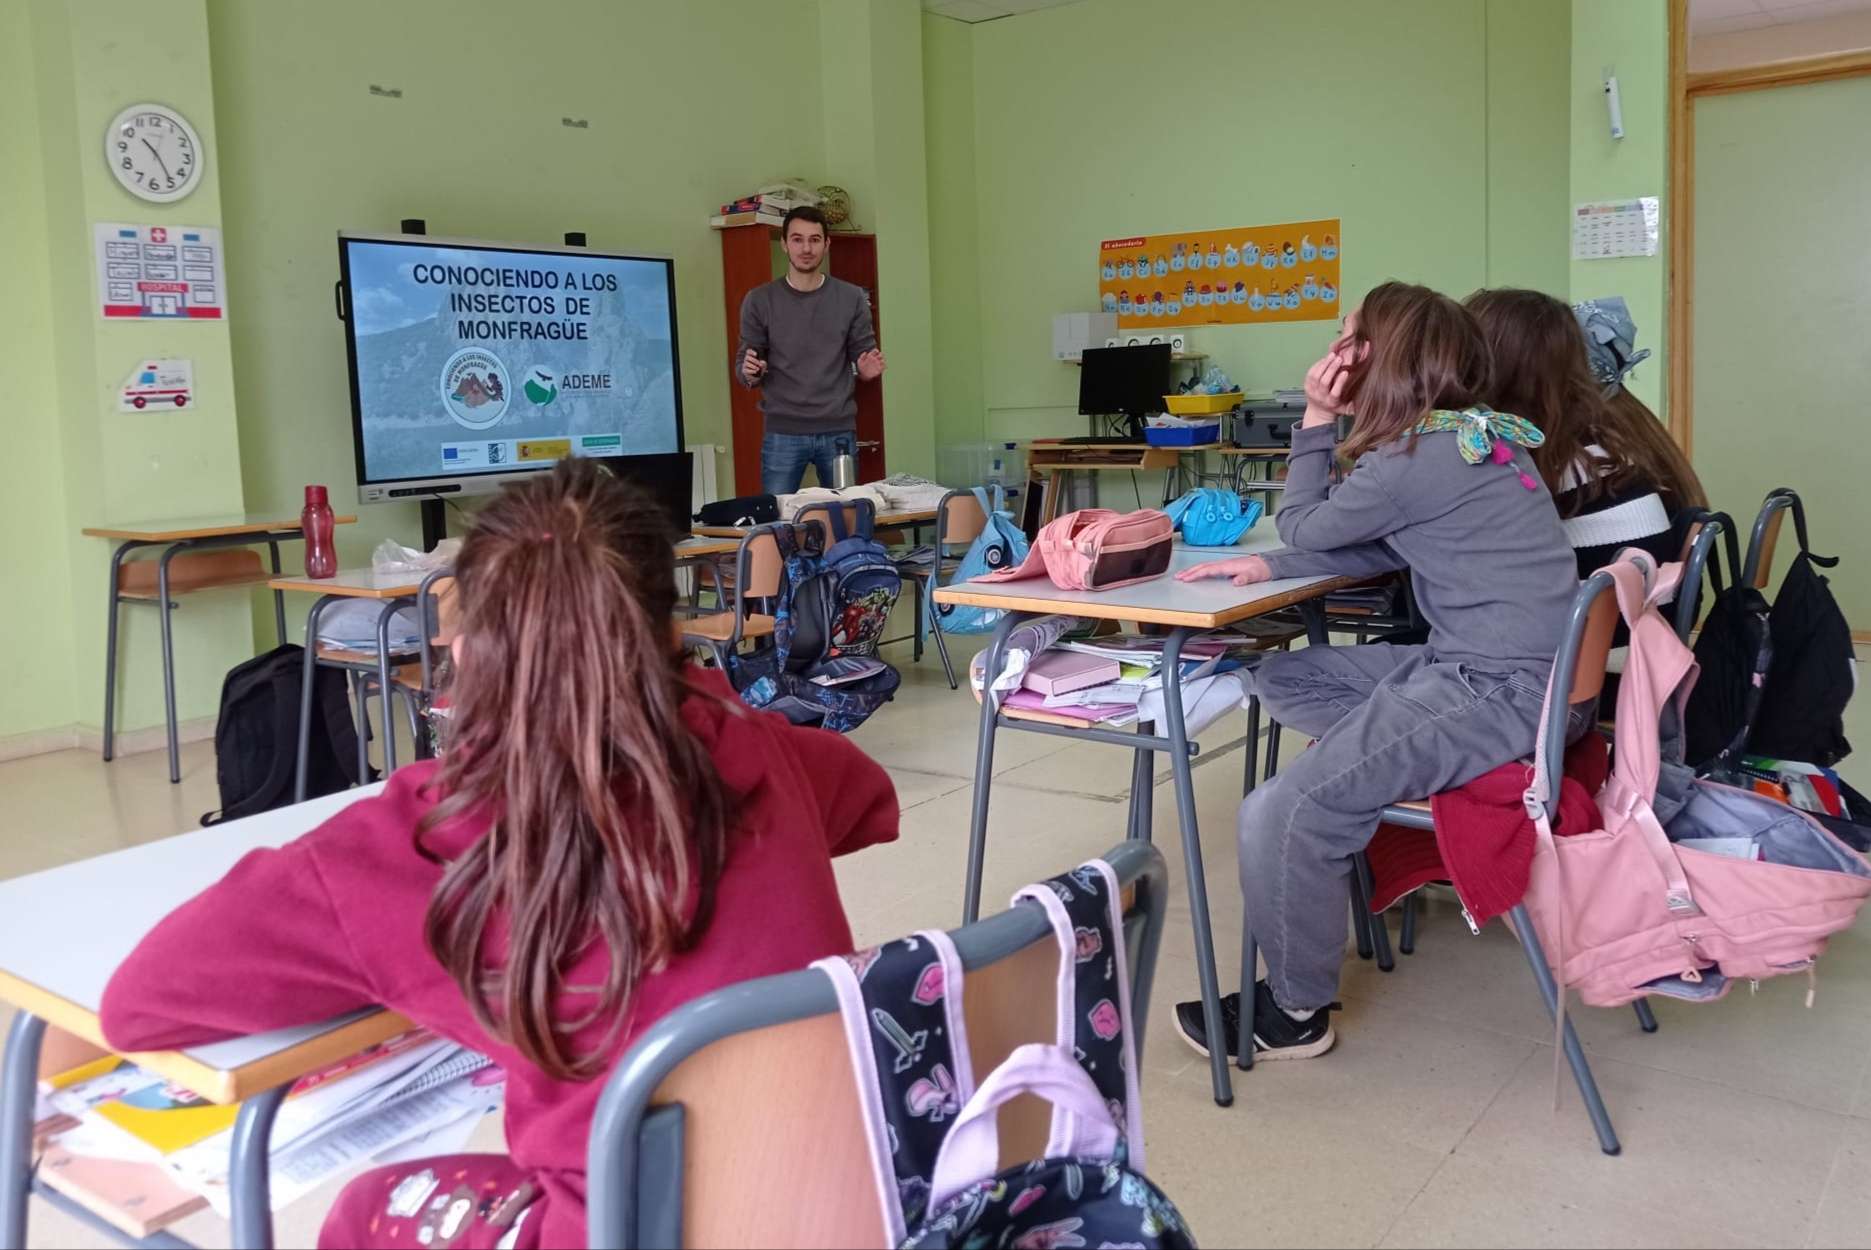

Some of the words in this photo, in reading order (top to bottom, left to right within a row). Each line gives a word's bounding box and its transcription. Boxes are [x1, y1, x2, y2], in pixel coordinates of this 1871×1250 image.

[149, 116, 161, 128] 12
[122, 127, 135, 138] 10
[118, 141, 128, 153] 9
[177, 137, 187, 148] 2
[122, 157, 133, 170] 8
[182, 153, 191, 165] 3
[135, 171, 144, 183] 7
[176, 168, 186, 179] 4
[148, 178, 159, 191] 6
[166, 176, 175, 189] 5
[413, 263, 559, 290] CONOCIENDO
[564, 272, 577, 290] A
[582, 273, 617, 292] LOS
[140, 282, 185, 292] HOSPITAL
[451, 293, 555, 315] INSECTOS
[565, 297, 591, 316] DE
[458, 318, 588, 340] MONFRAGÜE
[562, 374, 612, 389] ADEME
